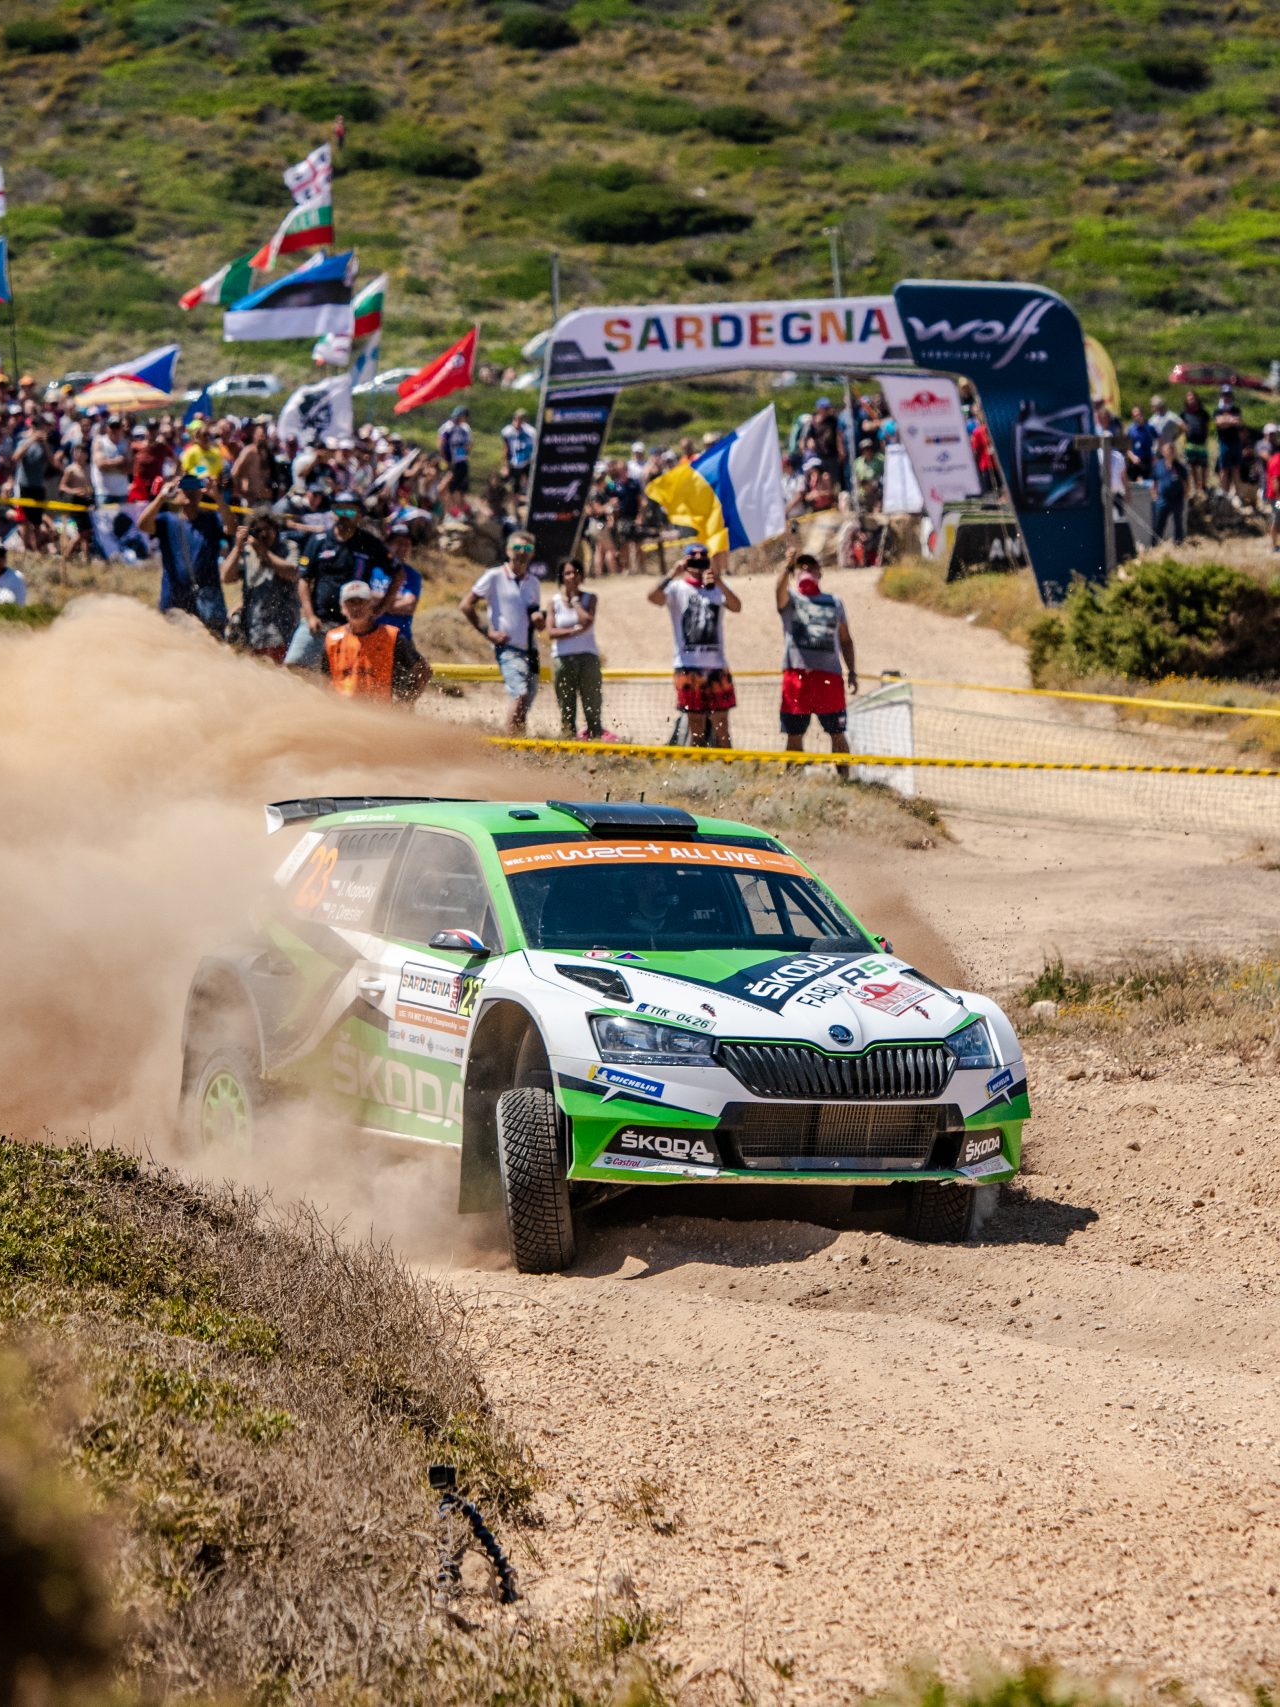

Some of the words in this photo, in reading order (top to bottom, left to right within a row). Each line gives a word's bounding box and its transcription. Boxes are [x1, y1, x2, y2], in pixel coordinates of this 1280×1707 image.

[603, 309, 891, 352] SARDEGNA
[504, 857, 525, 867] WRC
[534, 854, 553, 862] PRO
[670, 847, 710, 859] ALL
[711, 849, 761, 865] LIVE
[294, 845, 339, 908] 23
[744, 953, 846, 1000] ŠKODA
[837, 959, 888, 987] R5
[402, 974, 451, 998] SARDEGNA
[676, 1013, 710, 1029] 0426
[333, 1030, 464, 1128] ŠKODA
[609, 1074, 658, 1093] MICHELIN
[621, 1130, 709, 1155] ŠKODA
[965, 1136, 1000, 1156] ŠKODA
[612, 1157, 641, 1168] Castrol
